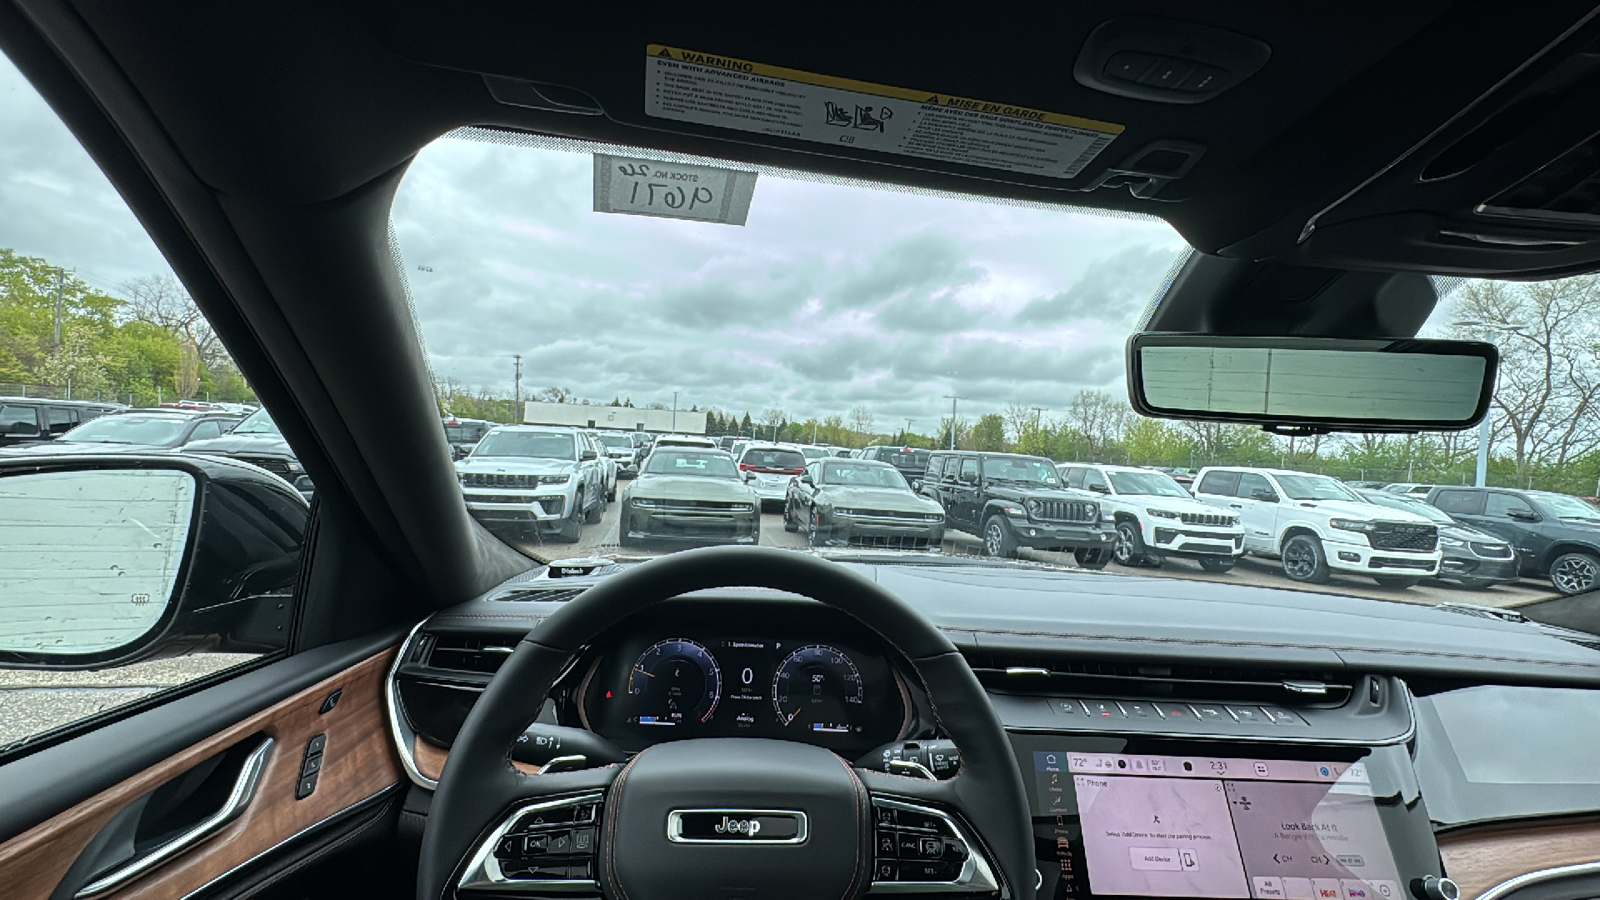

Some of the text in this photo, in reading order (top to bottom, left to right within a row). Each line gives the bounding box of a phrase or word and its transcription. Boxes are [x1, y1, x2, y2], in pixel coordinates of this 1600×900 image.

[682, 51, 753, 72] WARNING
[657, 60, 785, 88] EVEN WITH ADVANCED AIRBAGS
[947, 98, 1047, 121] MISE EN GARDE
[742, 667, 753, 685] 0
[788, 713, 794, 721] 0
[1073, 758, 1088, 767] 72°
[1210, 761, 1228, 771] 2:31
[1087, 780, 1108, 789] Phone
[715, 816, 761, 837] Jeep
[1281, 823, 1301, 831] Look
[1301, 823, 1320, 831] Back
[530, 840, 542, 848] OK
[1061, 873, 1074, 881] Apps
[1260, 888, 1280, 896] Presets
